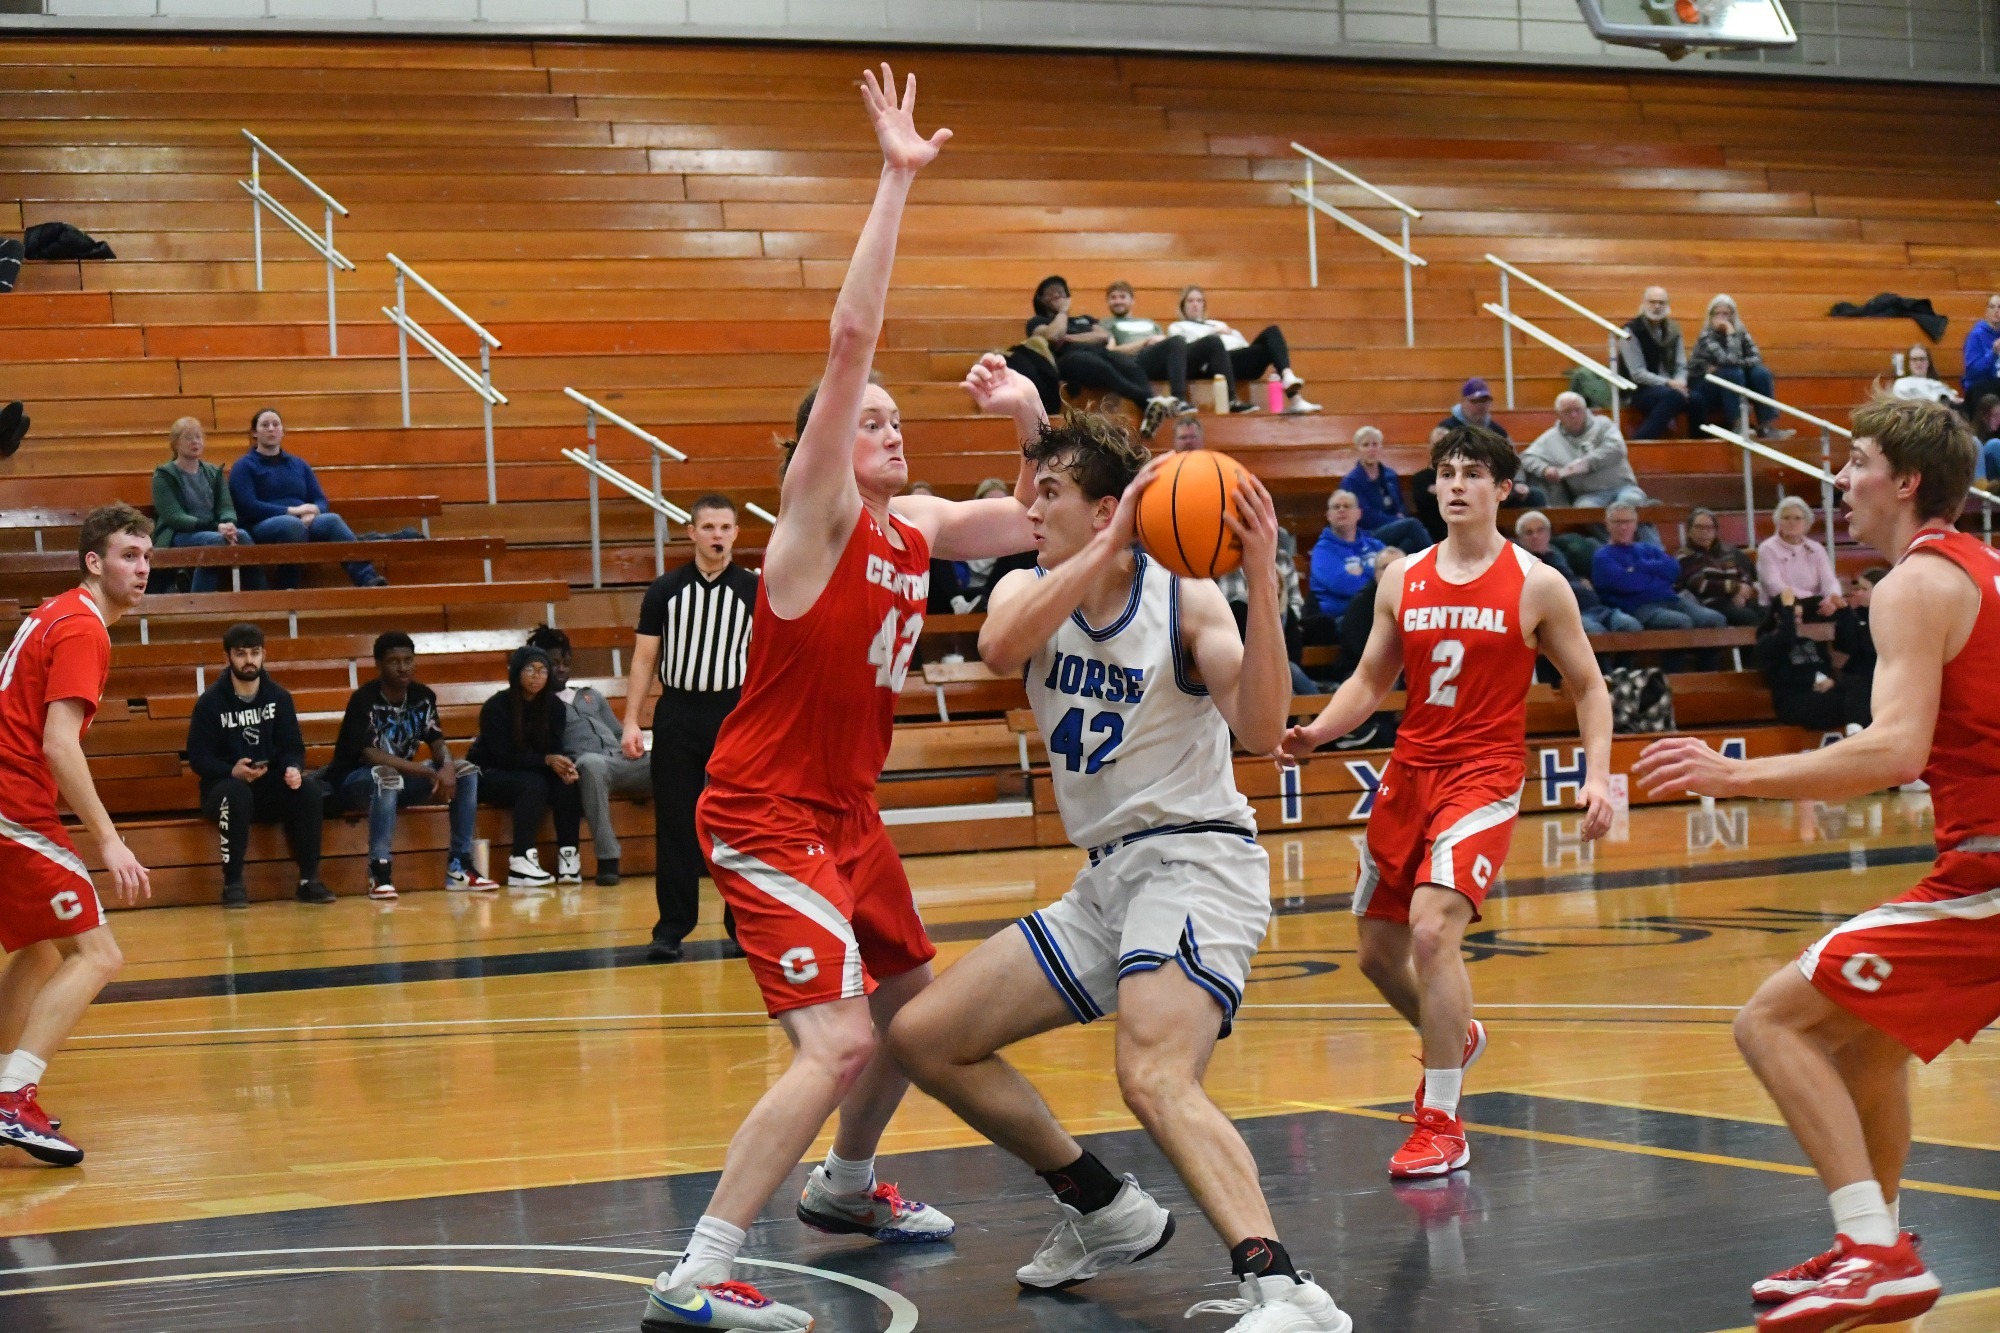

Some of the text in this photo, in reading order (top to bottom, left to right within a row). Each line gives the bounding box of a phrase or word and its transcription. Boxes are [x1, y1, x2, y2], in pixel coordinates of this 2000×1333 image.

[1403, 606, 1508, 634] CENTRAL
[867, 605, 924, 693] 42
[1424, 639, 1465, 708] 2
[1050, 707, 1124, 775] 42
[1471, 853, 1492, 890] C
[50, 890, 83, 920] C
[779, 946, 819, 984] C
[1841, 952, 1893, 992] C
